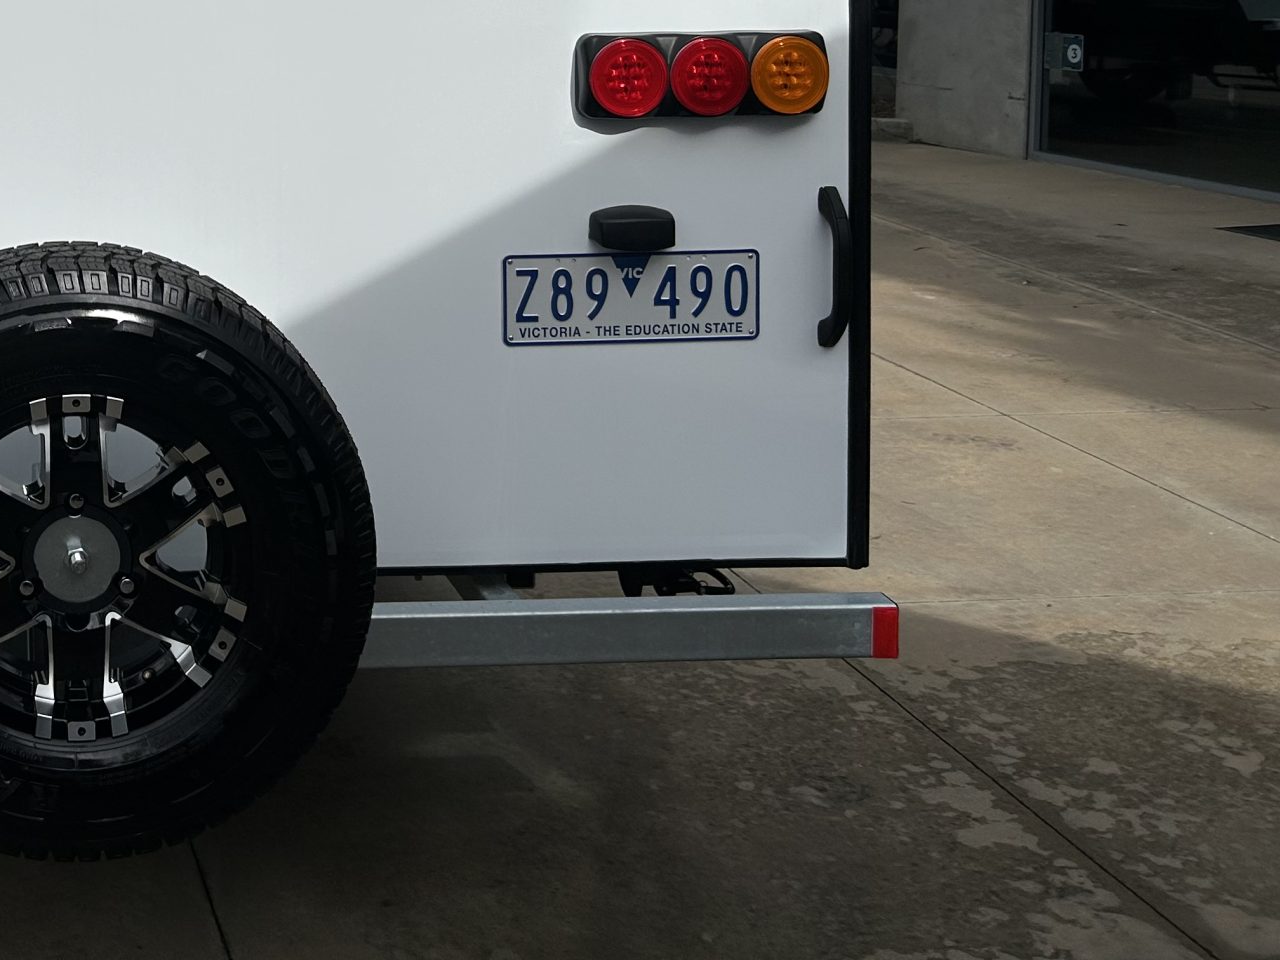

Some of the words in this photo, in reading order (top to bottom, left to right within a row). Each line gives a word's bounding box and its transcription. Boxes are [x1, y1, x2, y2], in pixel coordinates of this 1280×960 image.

[619, 267, 644, 279] VIC
[515, 267, 609, 323] Z89
[653, 263, 749, 319] 490
[519, 326, 581, 339] VICTORIA
[595, 325, 620, 337] THE
[625, 323, 699, 336] EDUCATION
[704, 321, 743, 334] STATE
